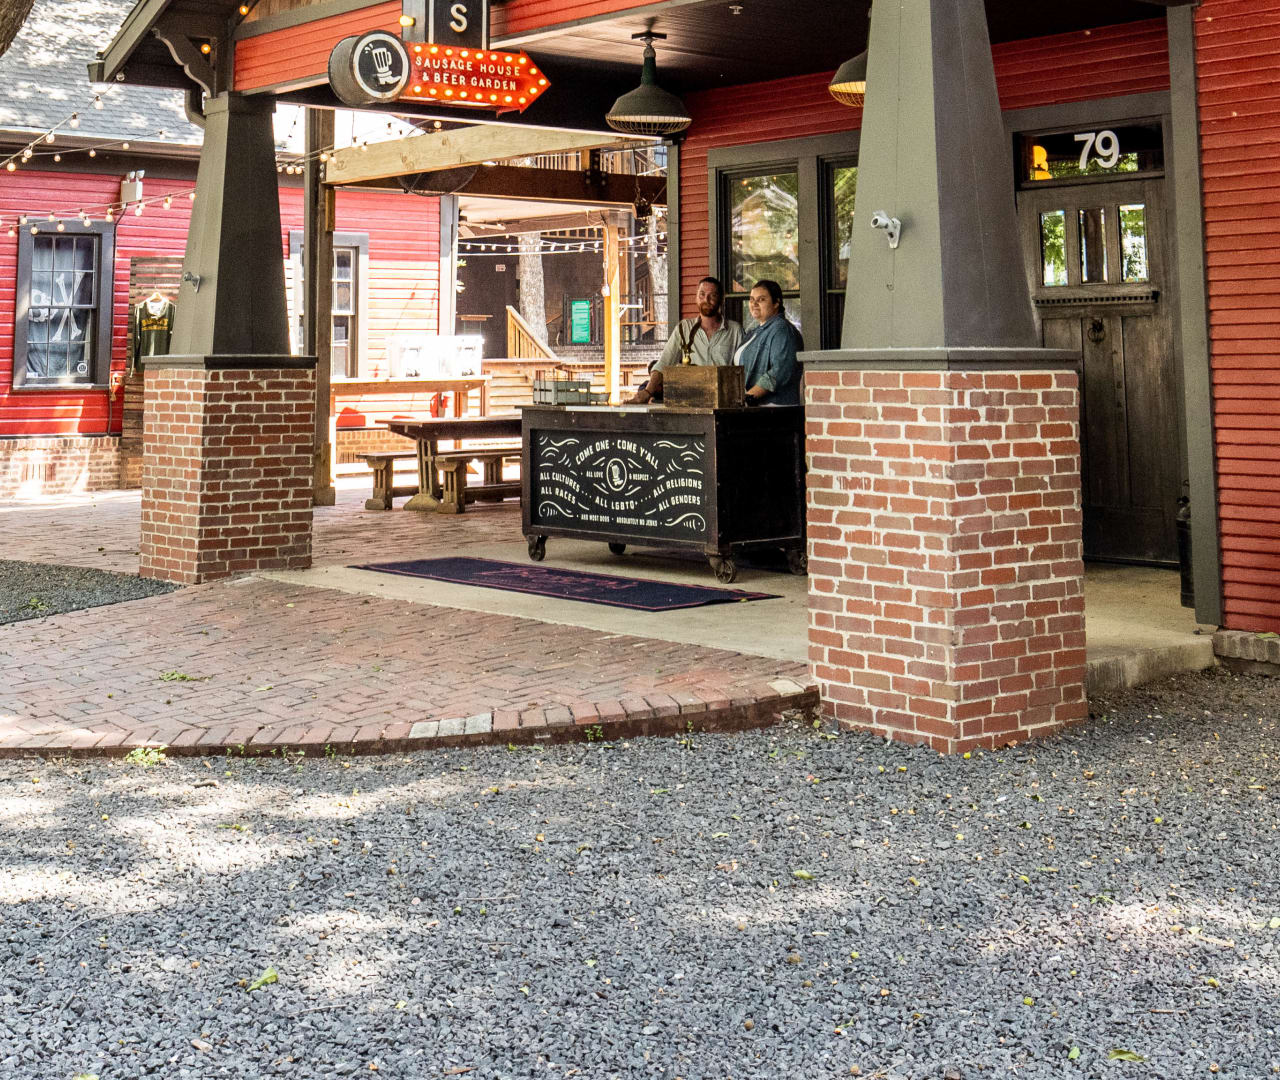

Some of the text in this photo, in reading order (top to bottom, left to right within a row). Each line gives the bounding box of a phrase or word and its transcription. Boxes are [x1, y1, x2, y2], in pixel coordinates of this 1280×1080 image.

[415, 56, 520, 76] SAUSAGE HOUSE
[422, 72, 517, 91] & BEER GARDEN
[1073, 130, 1120, 170] 79
[575, 439, 659, 470] COME ONE COME Y'ALL
[540, 471, 580, 493] ALL CULTURES
[653, 477, 702, 498] ALL RELIGIONS
[540, 486, 576, 505] ALL RACES
[595, 495, 608, 508] ALL
[658, 494, 701, 512] ALL GENDERS
